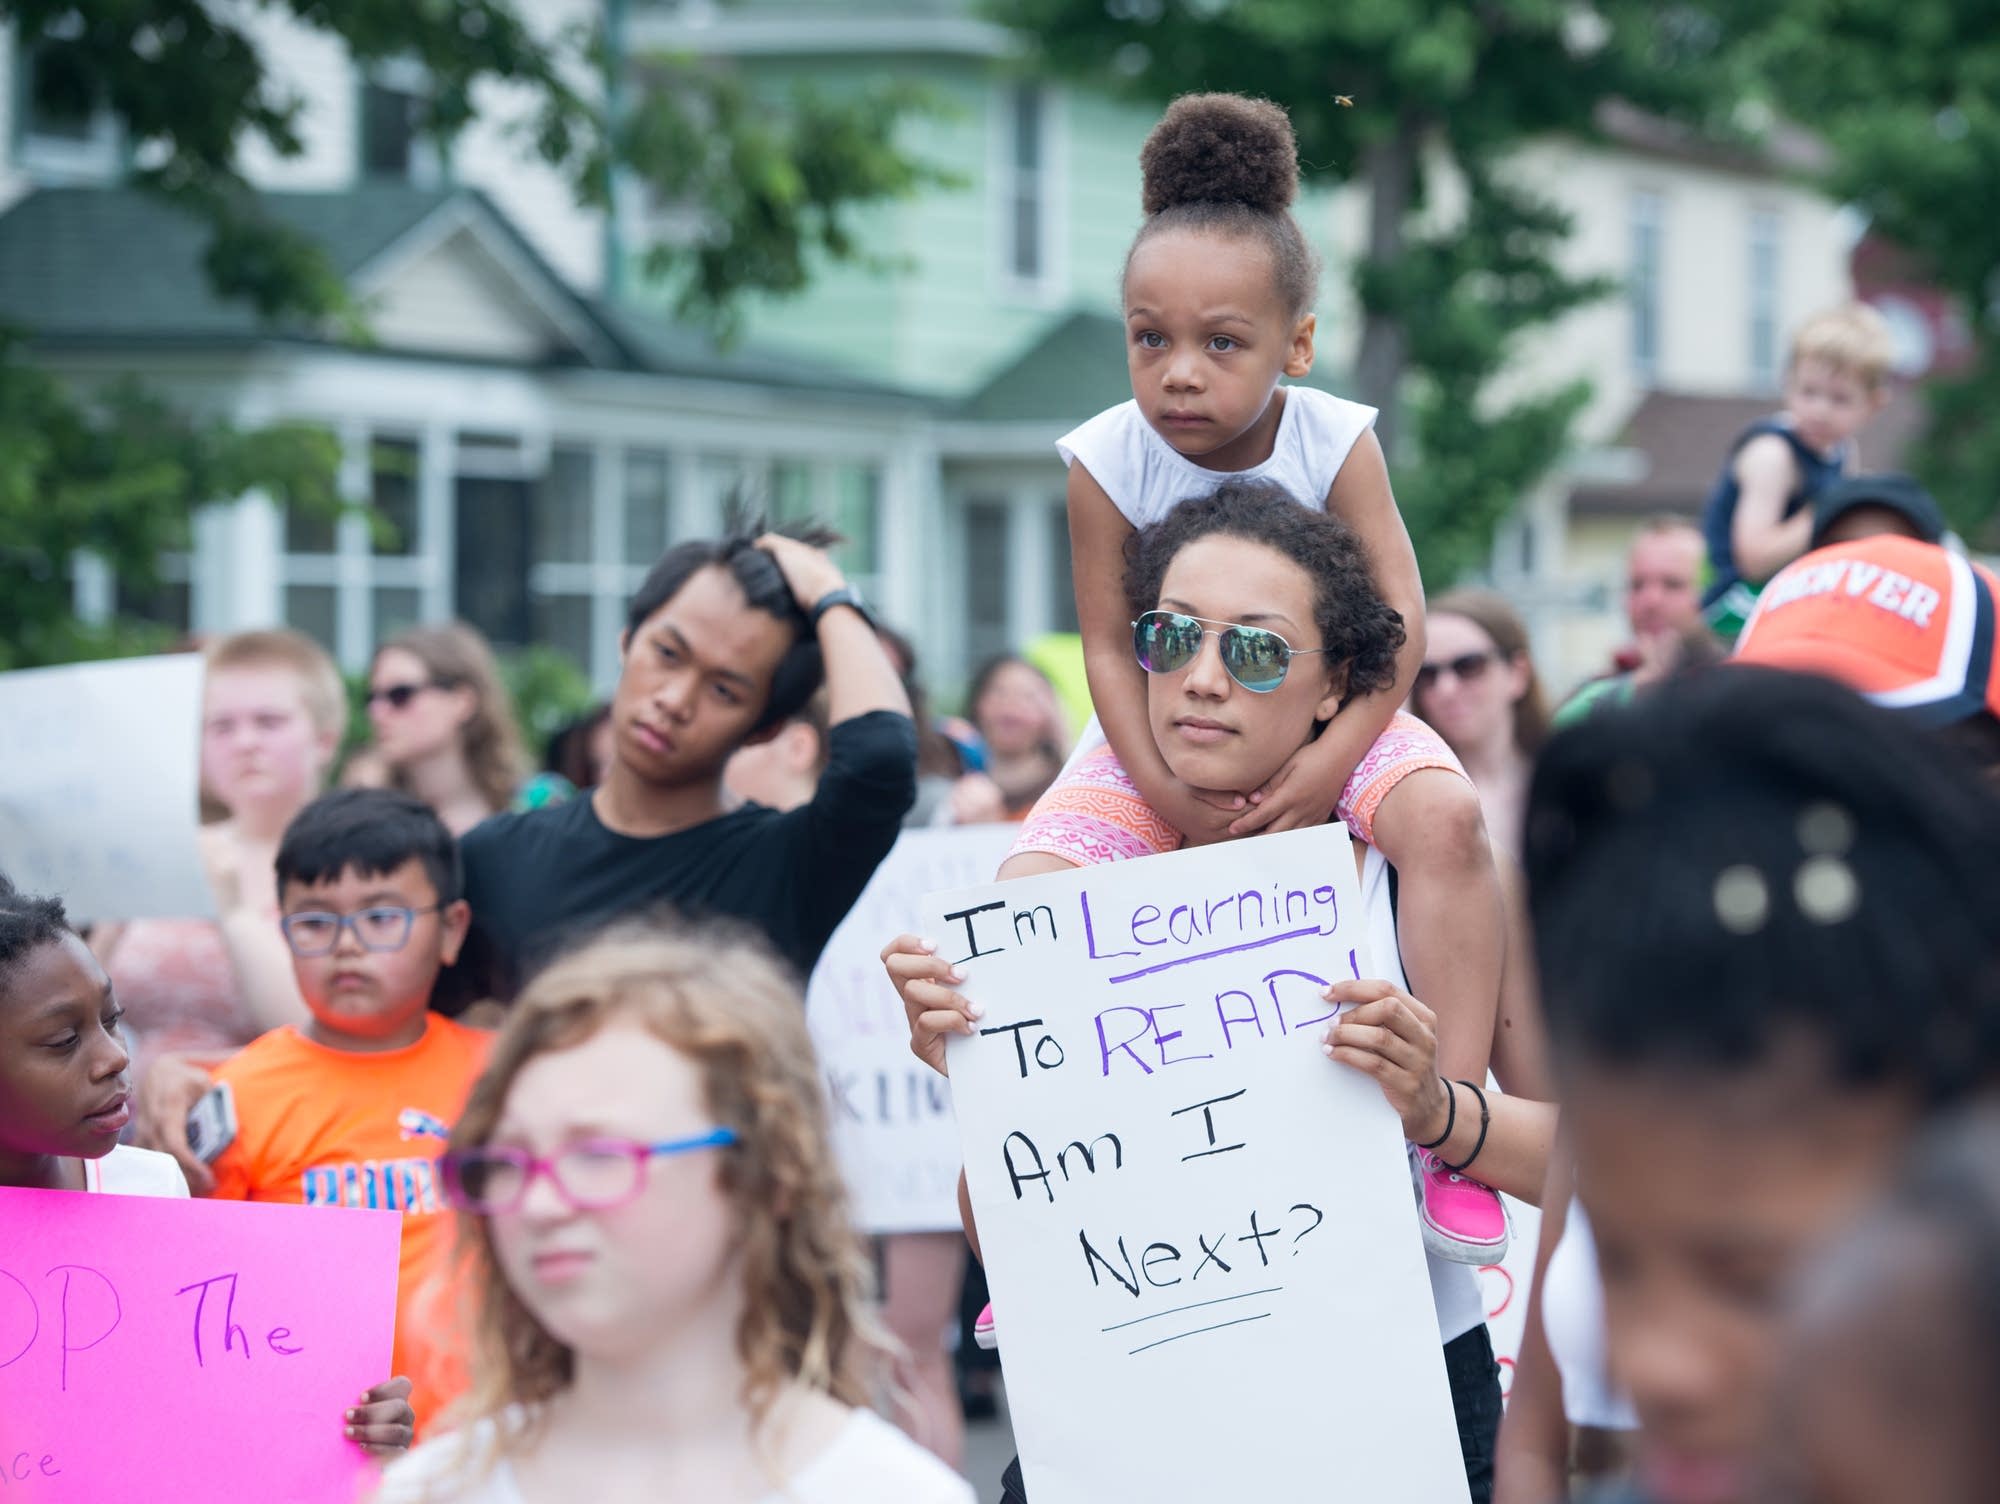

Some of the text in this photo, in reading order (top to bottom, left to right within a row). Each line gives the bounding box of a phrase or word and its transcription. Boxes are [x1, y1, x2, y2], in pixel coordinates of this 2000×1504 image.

[1081, 883, 1339, 959] Learning
[980, 1018, 1065, 1078] To
[1003, 1130, 1123, 1203] Am
[1171, 1088, 1247, 1162] I
[1079, 1203, 1324, 1298] Next?
[175, 1272, 304, 1368] The
